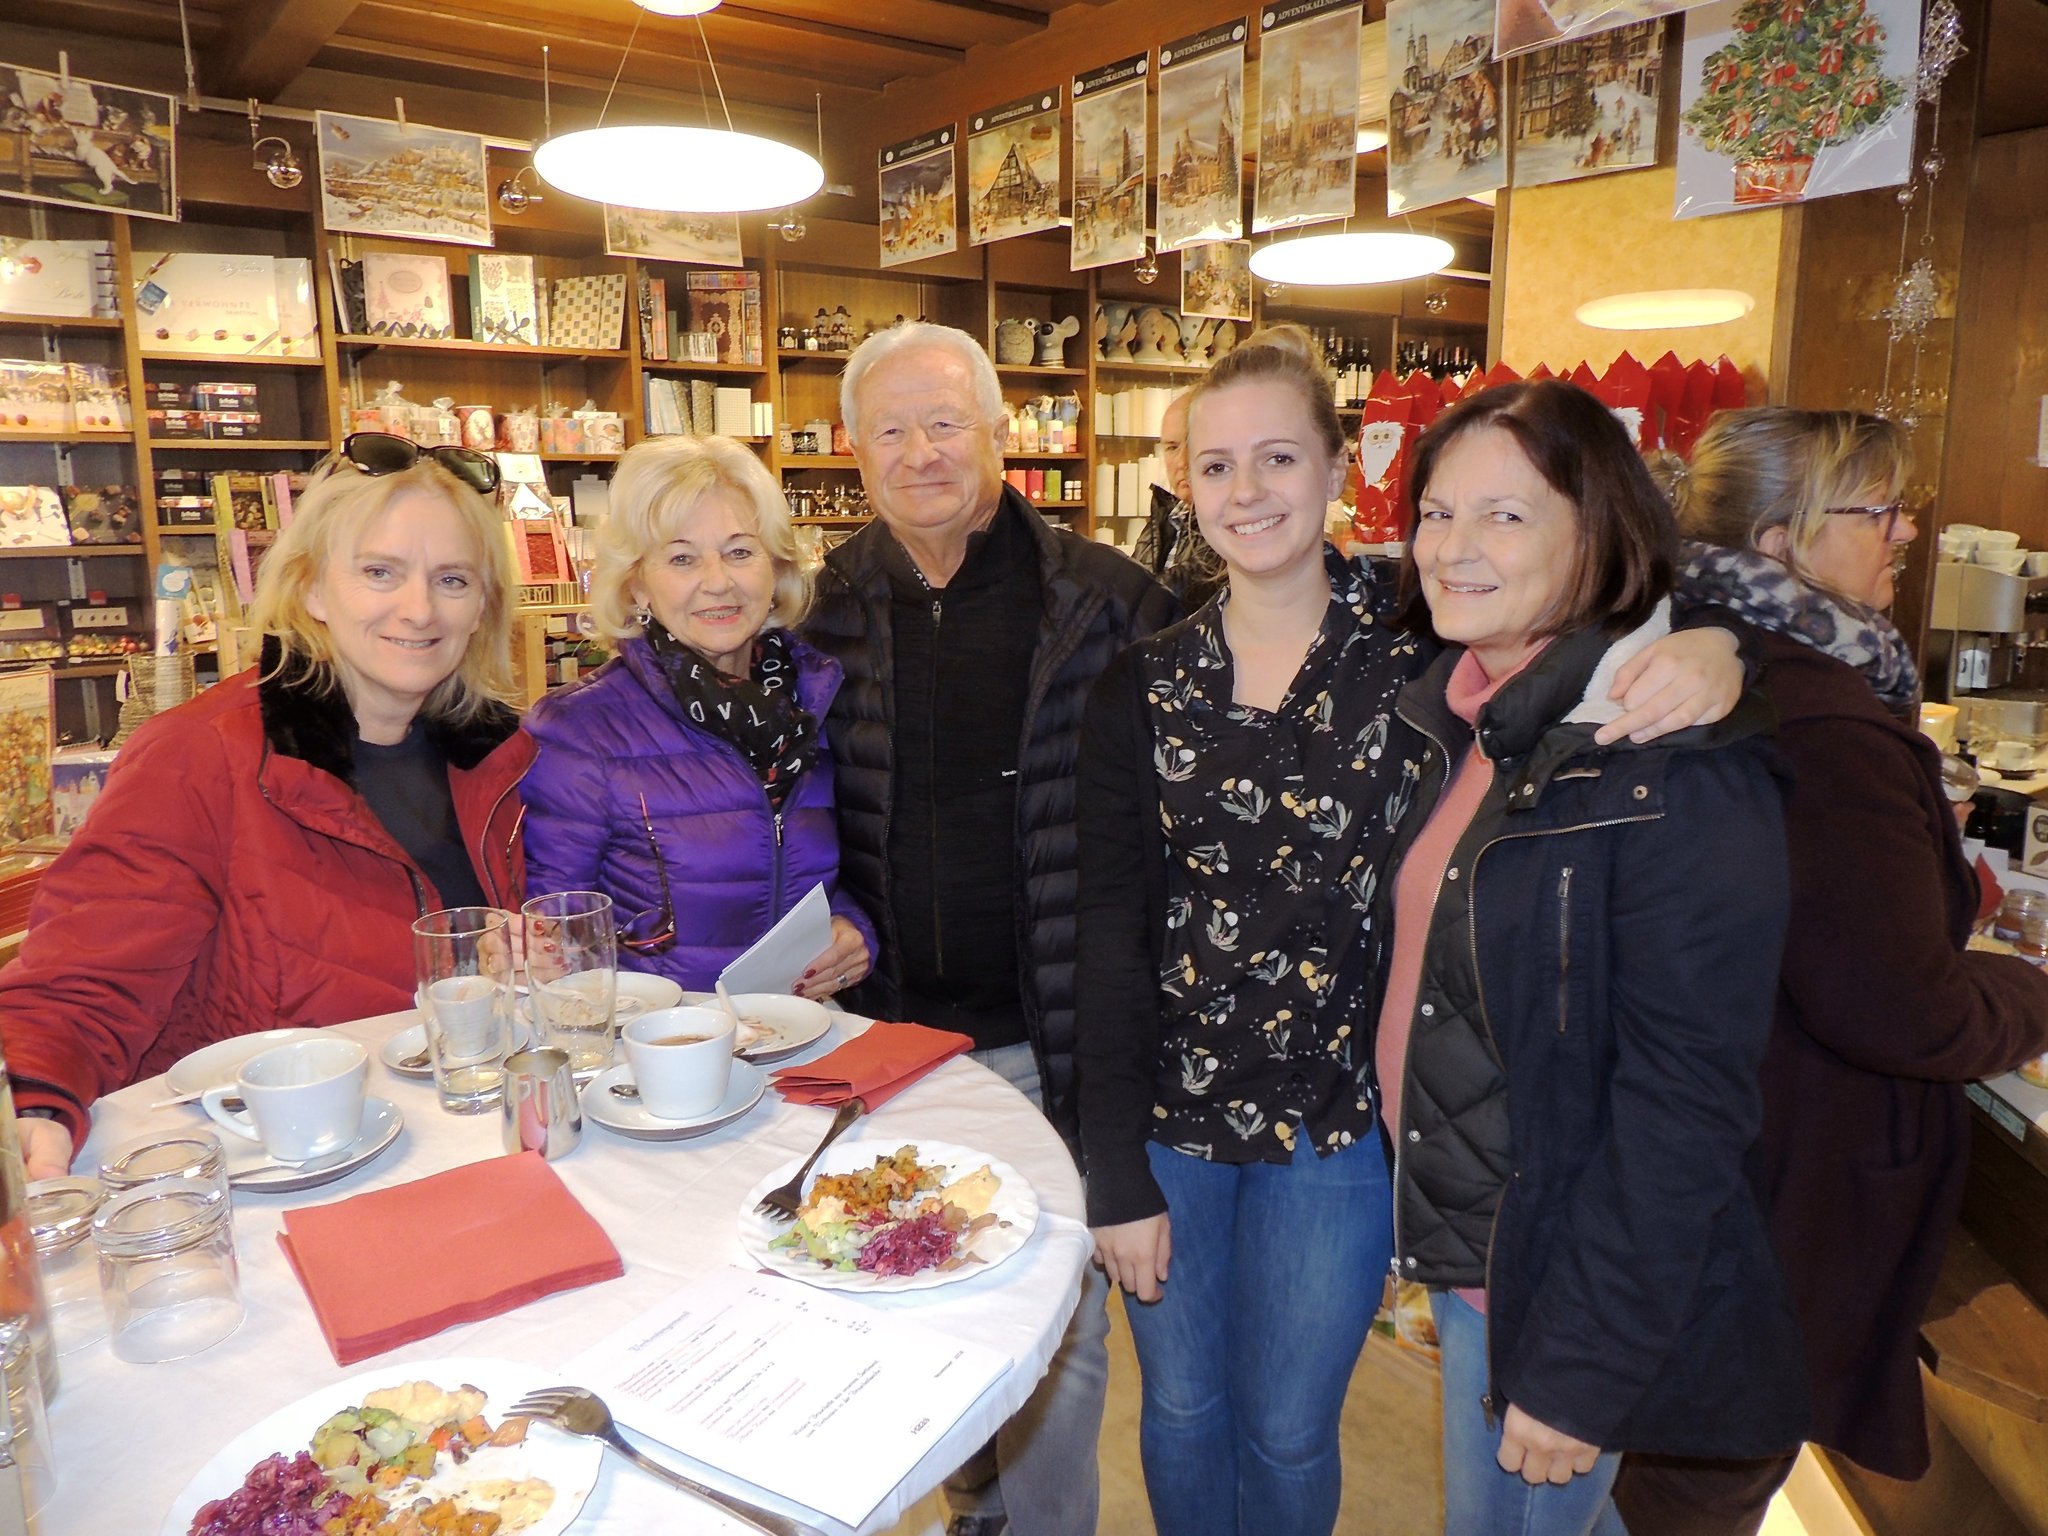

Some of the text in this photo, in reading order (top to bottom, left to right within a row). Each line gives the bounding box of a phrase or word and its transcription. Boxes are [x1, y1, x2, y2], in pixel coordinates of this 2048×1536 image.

[1277, 0, 1341, 21] ADVENTSKALEND
[1172, 32, 1231, 60] ADVENTSKALENDER
[1085, 66, 1136, 89] ADVENTSKALENDER
